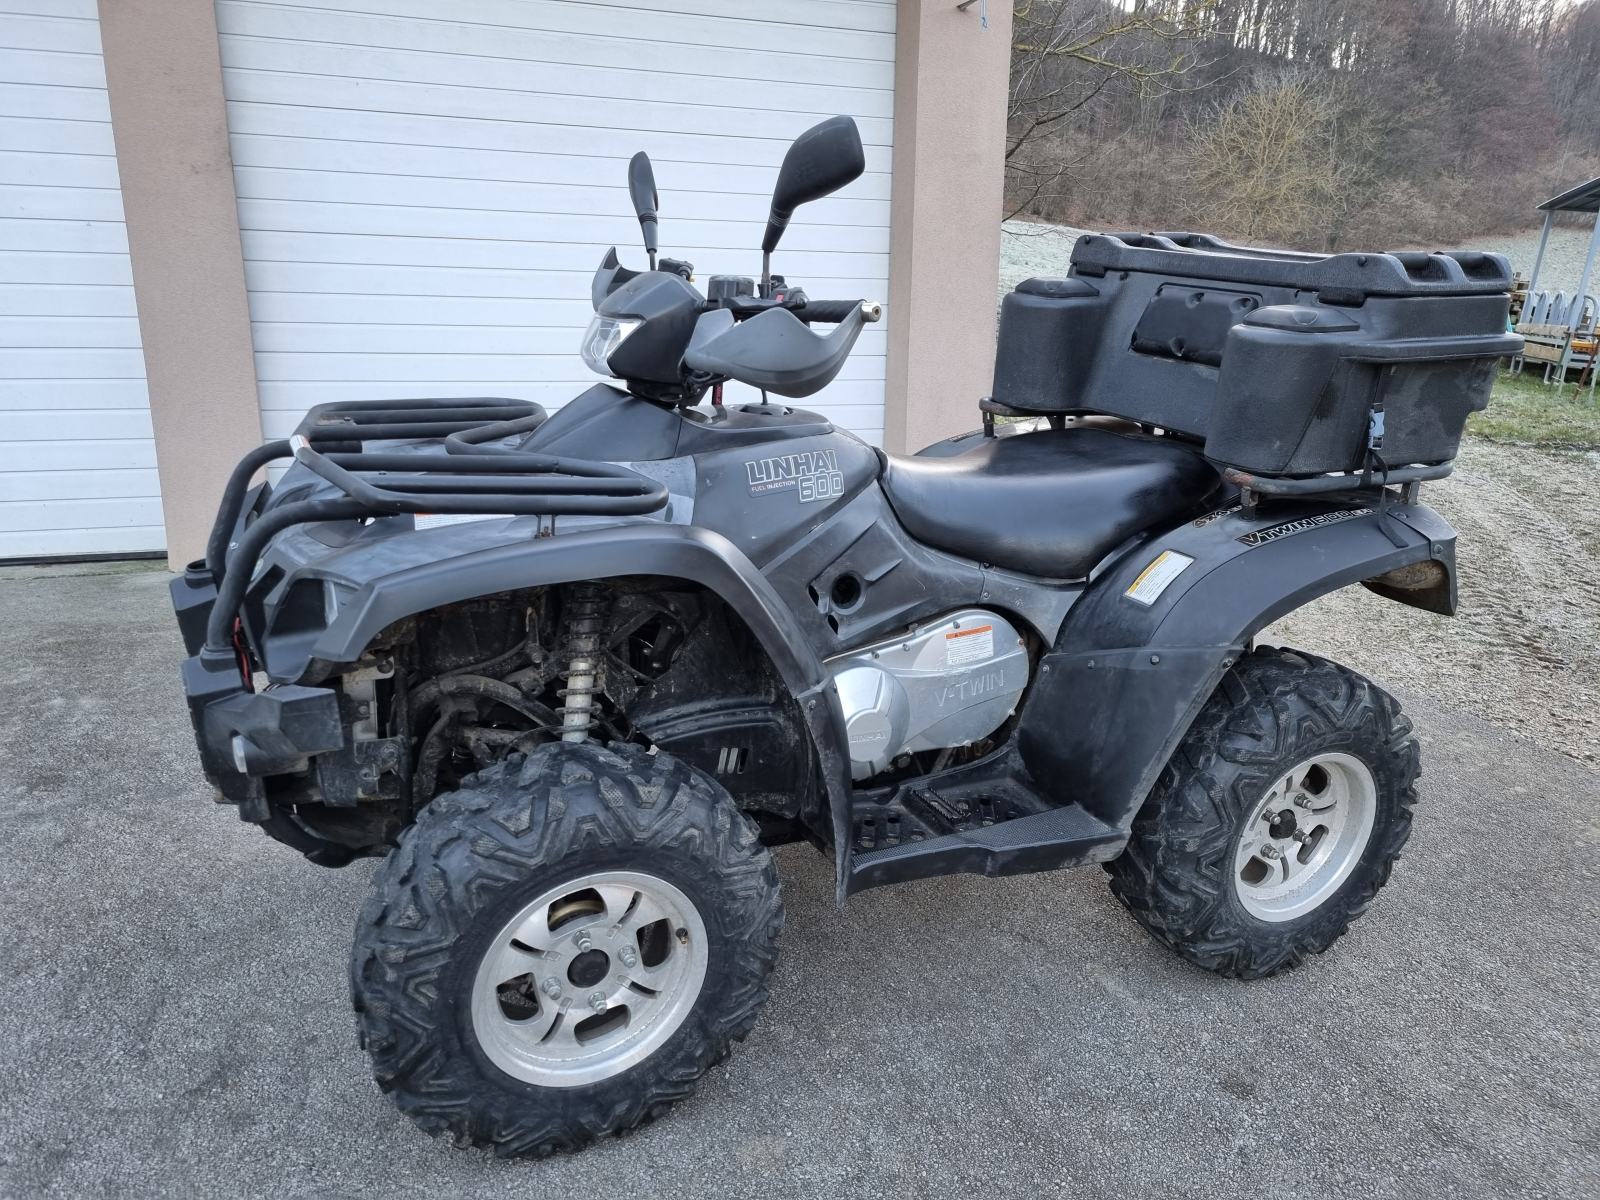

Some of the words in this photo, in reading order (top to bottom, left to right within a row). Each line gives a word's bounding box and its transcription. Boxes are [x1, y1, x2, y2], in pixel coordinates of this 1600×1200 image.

[745, 450, 838, 485] LINHAI
[766, 480, 796, 489] INJECTION
[799, 471, 844, 501] 600
[934, 669, 1004, 707] V-TWIN
